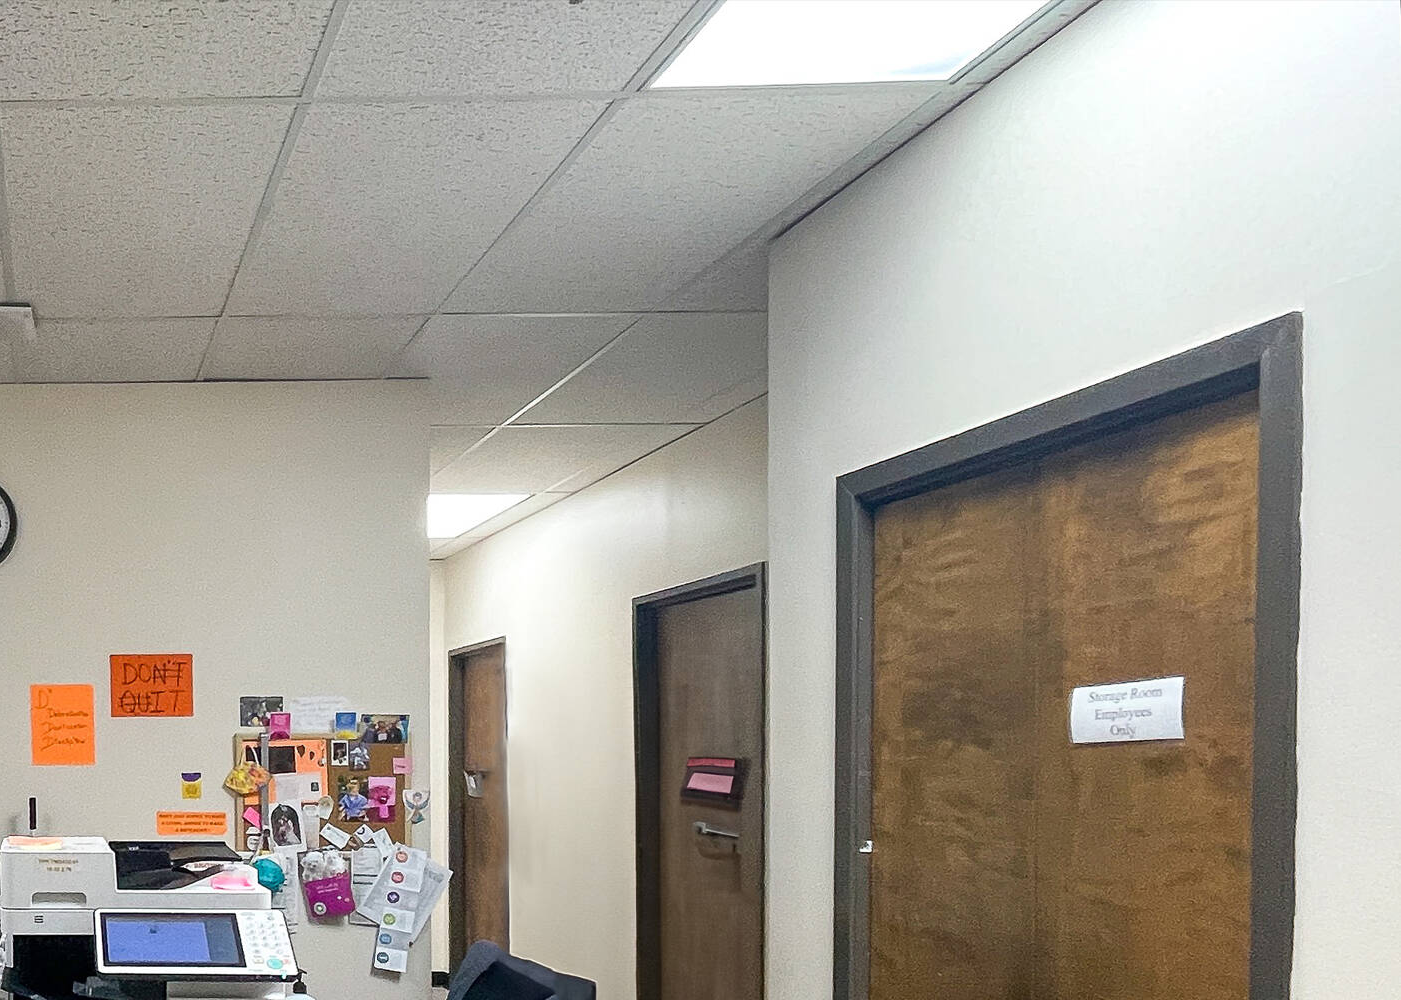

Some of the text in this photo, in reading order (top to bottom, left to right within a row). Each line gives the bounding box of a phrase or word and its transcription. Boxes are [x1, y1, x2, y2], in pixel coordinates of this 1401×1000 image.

[119, 689, 186, 714] QUIT
[1088, 687, 1163, 703] Storage Room
[1094, 708, 1153, 722] Employees
[1109, 724, 1137, 739] Only
